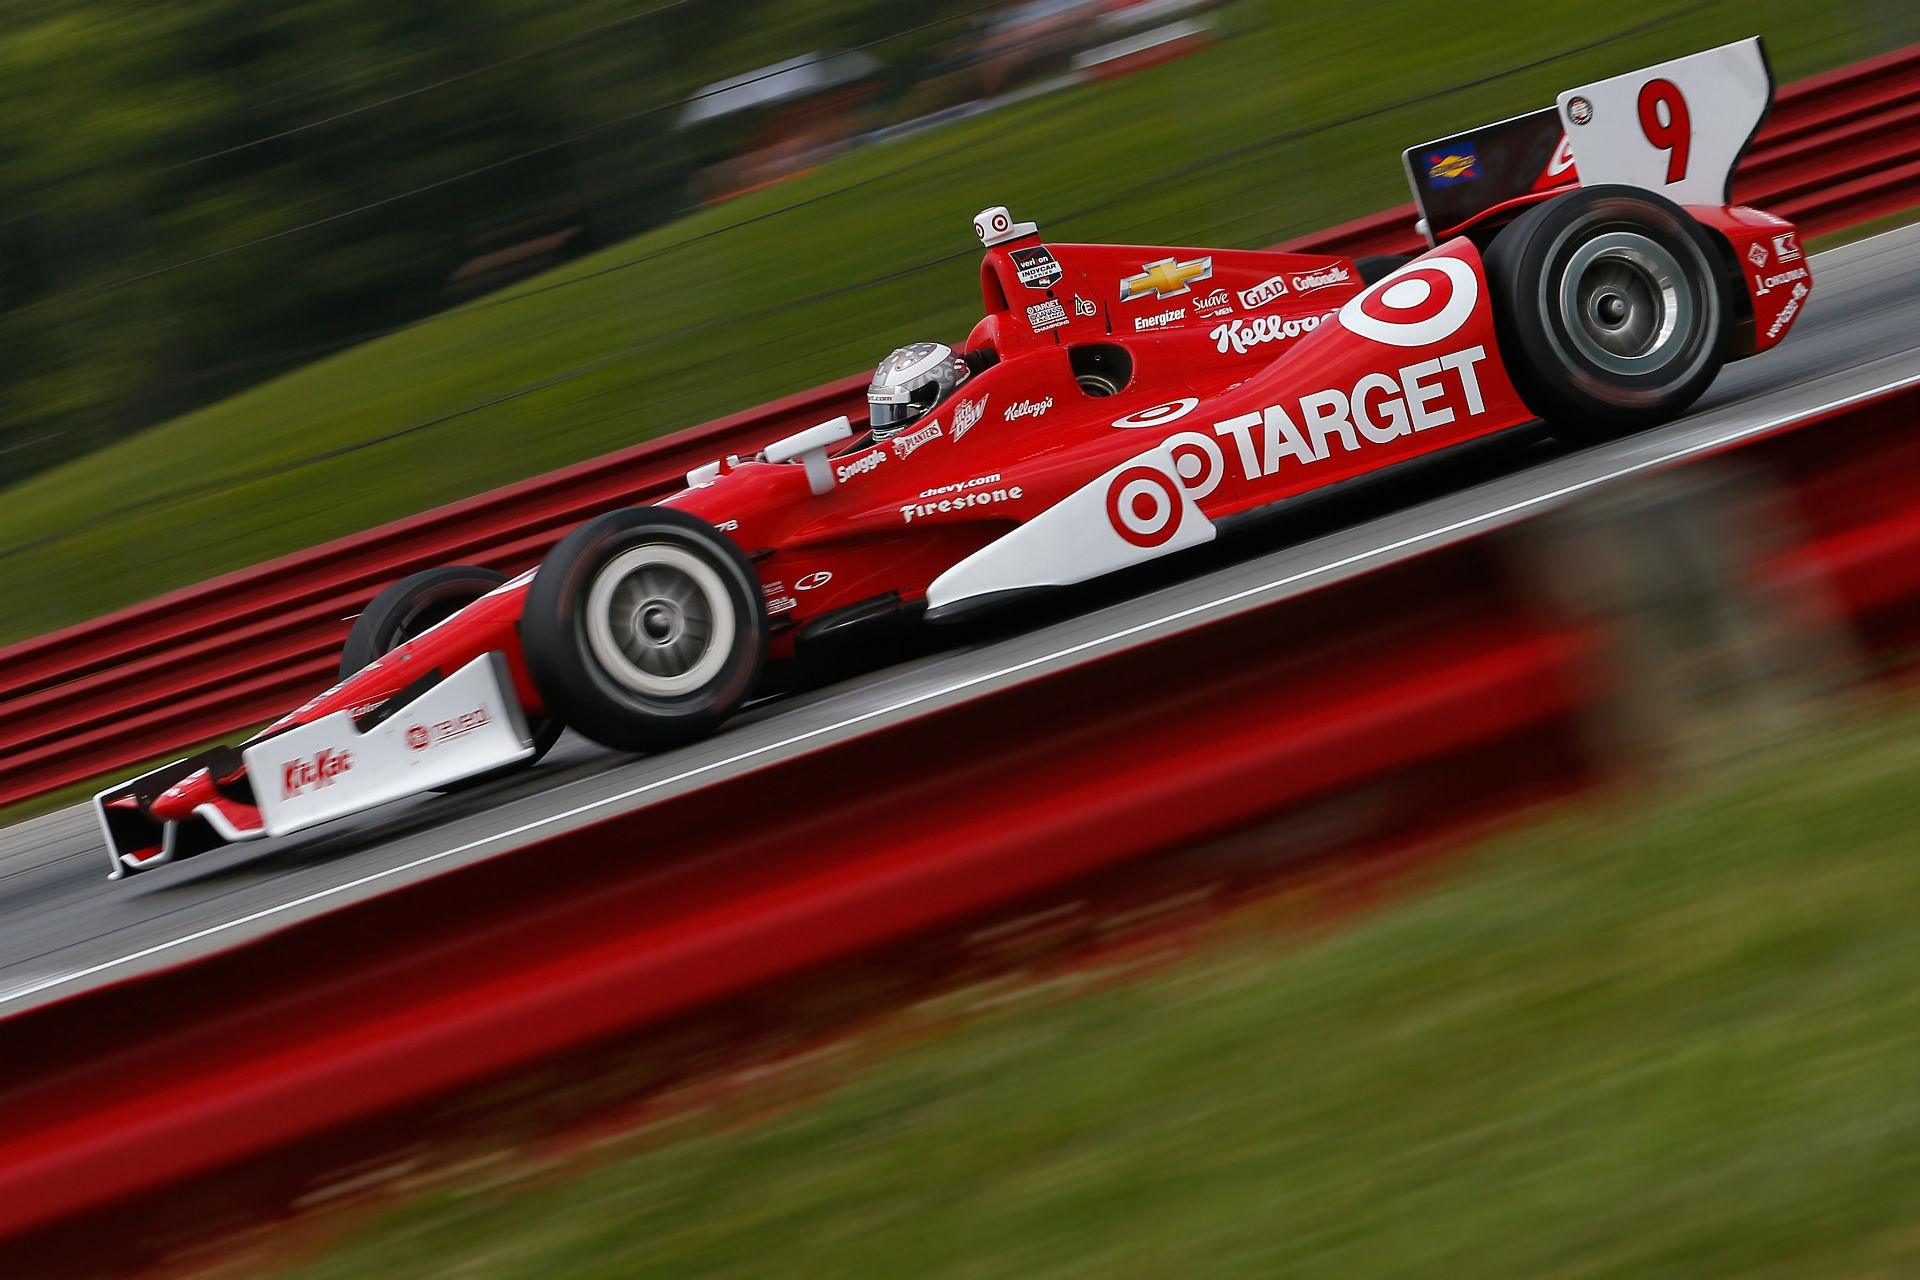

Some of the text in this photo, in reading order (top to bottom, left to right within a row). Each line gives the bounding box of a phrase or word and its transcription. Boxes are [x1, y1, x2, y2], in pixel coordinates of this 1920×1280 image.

[1637, 78, 1691, 186] 9
[1021, 263, 1057, 278] INDYCAR
[1291, 267, 1350, 291] Cottonelle
[1032, 299, 1059, 313] TARGET
[1192, 291, 1230, 312] Suave
[1243, 280, 1285, 307] GLAD
[1134, 308, 1186, 330] Energizer
[1004, 396, 1054, 422] Kellogg's
[1213, 344, 1487, 481] TARGET
[905, 424, 940, 450] PLANTERS
[836, 450, 887, 483] Snuggle
[919, 473, 1001, 498] chevy.com
[900, 486, 1023, 523] Firestone
